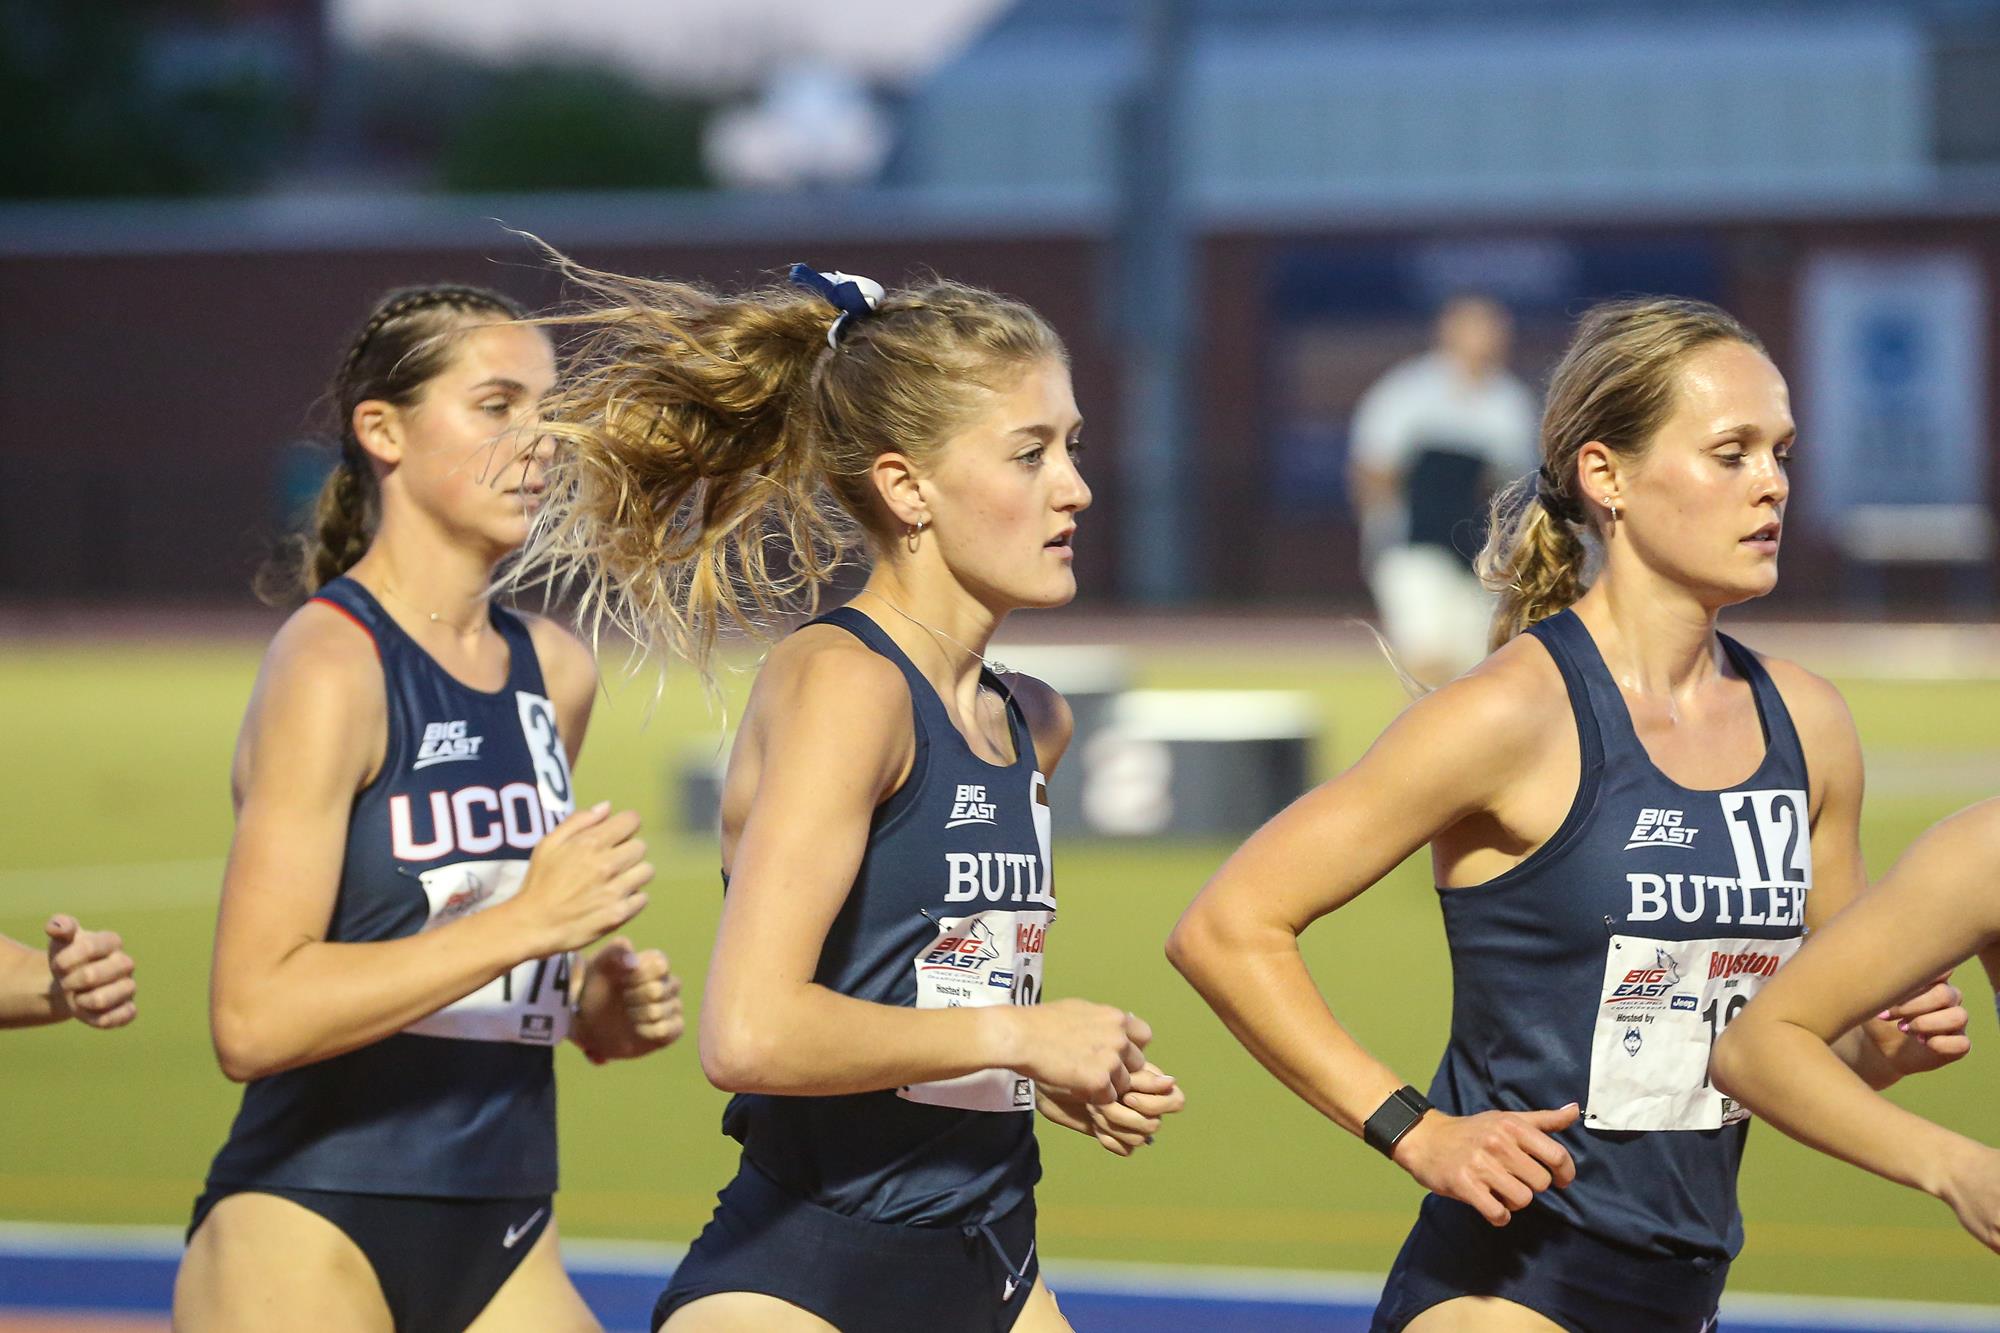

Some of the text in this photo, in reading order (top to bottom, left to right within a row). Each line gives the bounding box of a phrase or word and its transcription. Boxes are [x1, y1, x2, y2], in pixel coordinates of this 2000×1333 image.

[424, 720, 467, 740] BIG
[417, 736, 484, 758] EAST
[955, 784, 986, 803] BIG
[950, 802, 997, 820] EAST
[1636, 808, 1684, 827] BIG
[1629, 826, 1699, 844] EAST
[1732, 794, 1805, 883] 12
[1626, 873, 1806, 927] BUTLER
[935, 937, 984, 954] BIG
[923, 950, 991, 970] EAST
[1707, 951, 1780, 980] Royston
[1622, 969, 1667, 984] BIG
[1612, 984, 1673, 997] EAST
[1616, 1013, 1655, 1024] Hosted by
